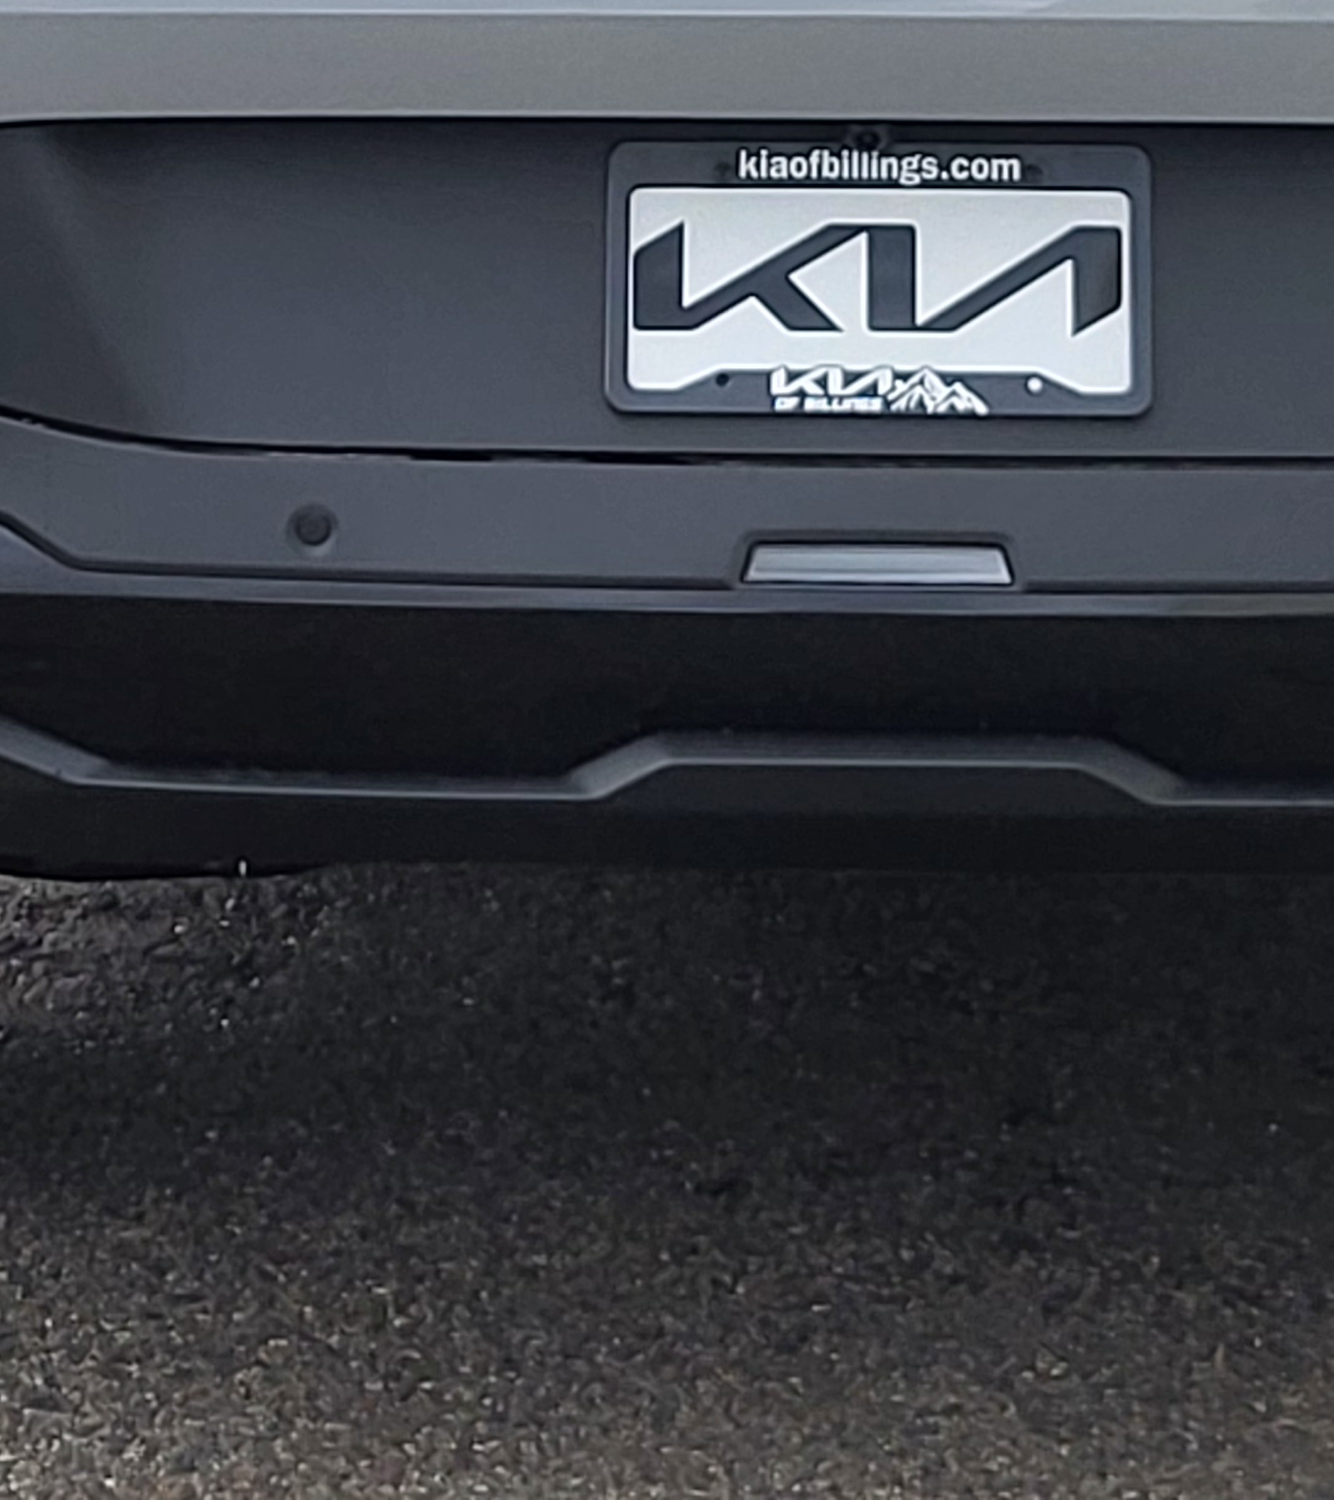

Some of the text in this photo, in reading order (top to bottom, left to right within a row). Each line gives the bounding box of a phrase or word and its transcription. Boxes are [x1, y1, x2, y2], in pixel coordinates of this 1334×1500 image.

[738, 148, 1021, 185] kiaofbillings.com
[633, 219, 1122, 337] KIA
[770, 366, 893, 395] KIA
